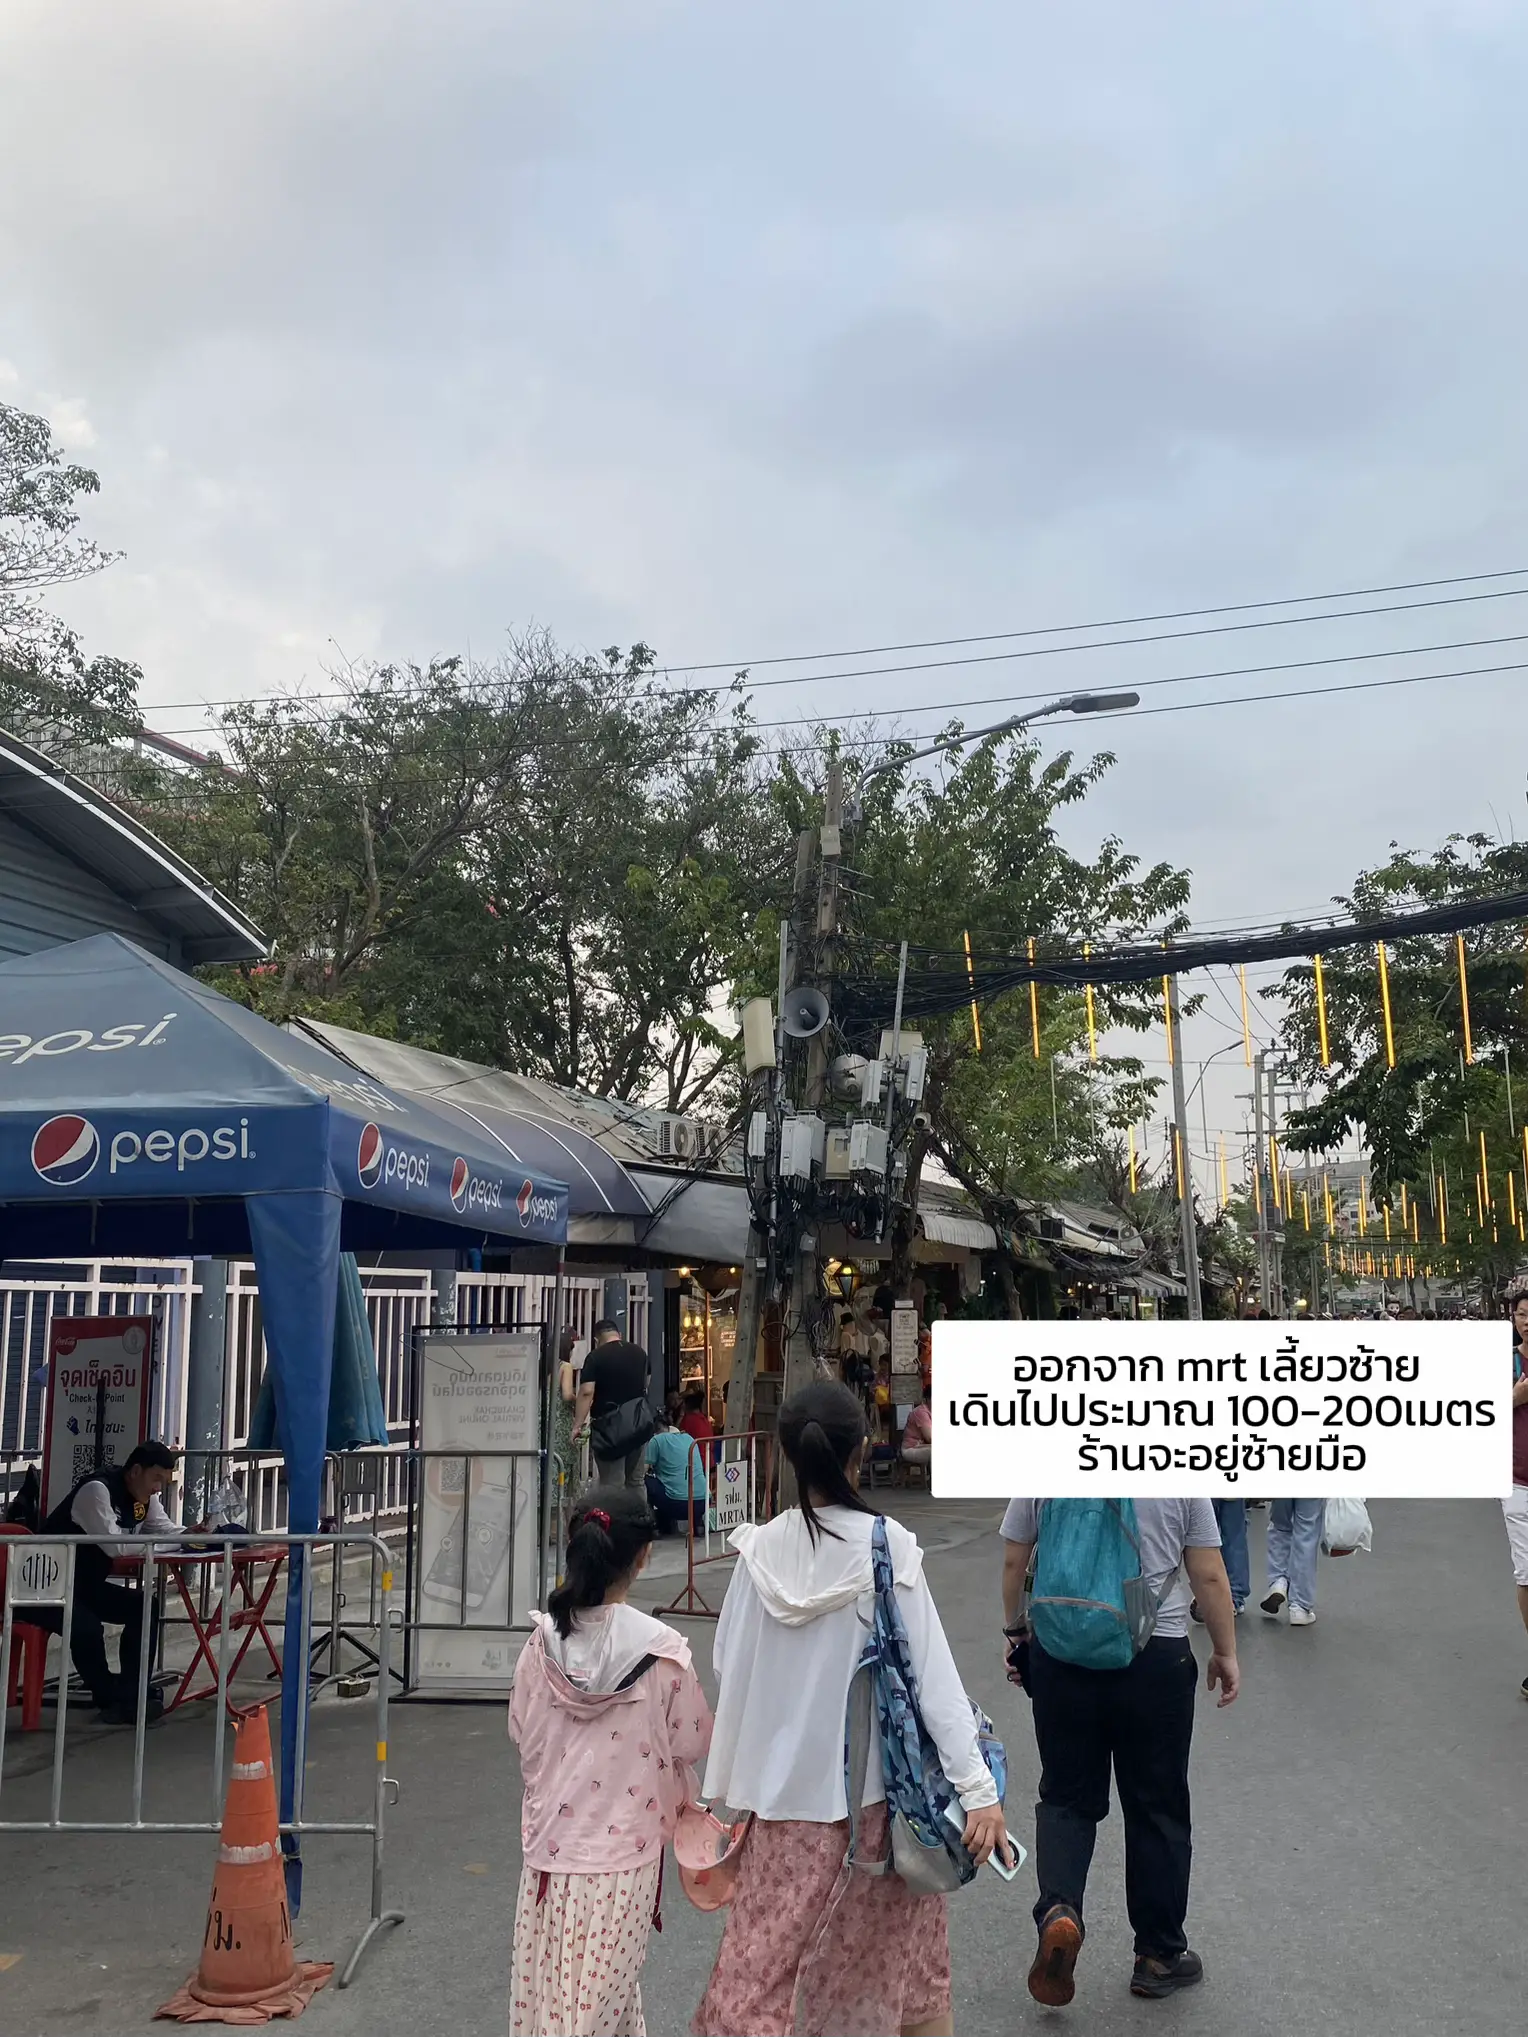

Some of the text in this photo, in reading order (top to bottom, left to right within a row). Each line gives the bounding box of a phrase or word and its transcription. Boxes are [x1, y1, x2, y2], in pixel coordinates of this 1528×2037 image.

[0, 1013, 178, 1065] epsi
[109, 1117, 249, 1174] pepsi
[384, 1147, 431, 1190] pepsi
[468, 1177, 503, 1212] pepsi
[531, 1195, 558, 1225] pepsi
[69, 1392, 125, 1403] Check- Point
[85, 1419, 126, 1434] ไทชนะ
[719, 1508, 745, 1525] MRTA
